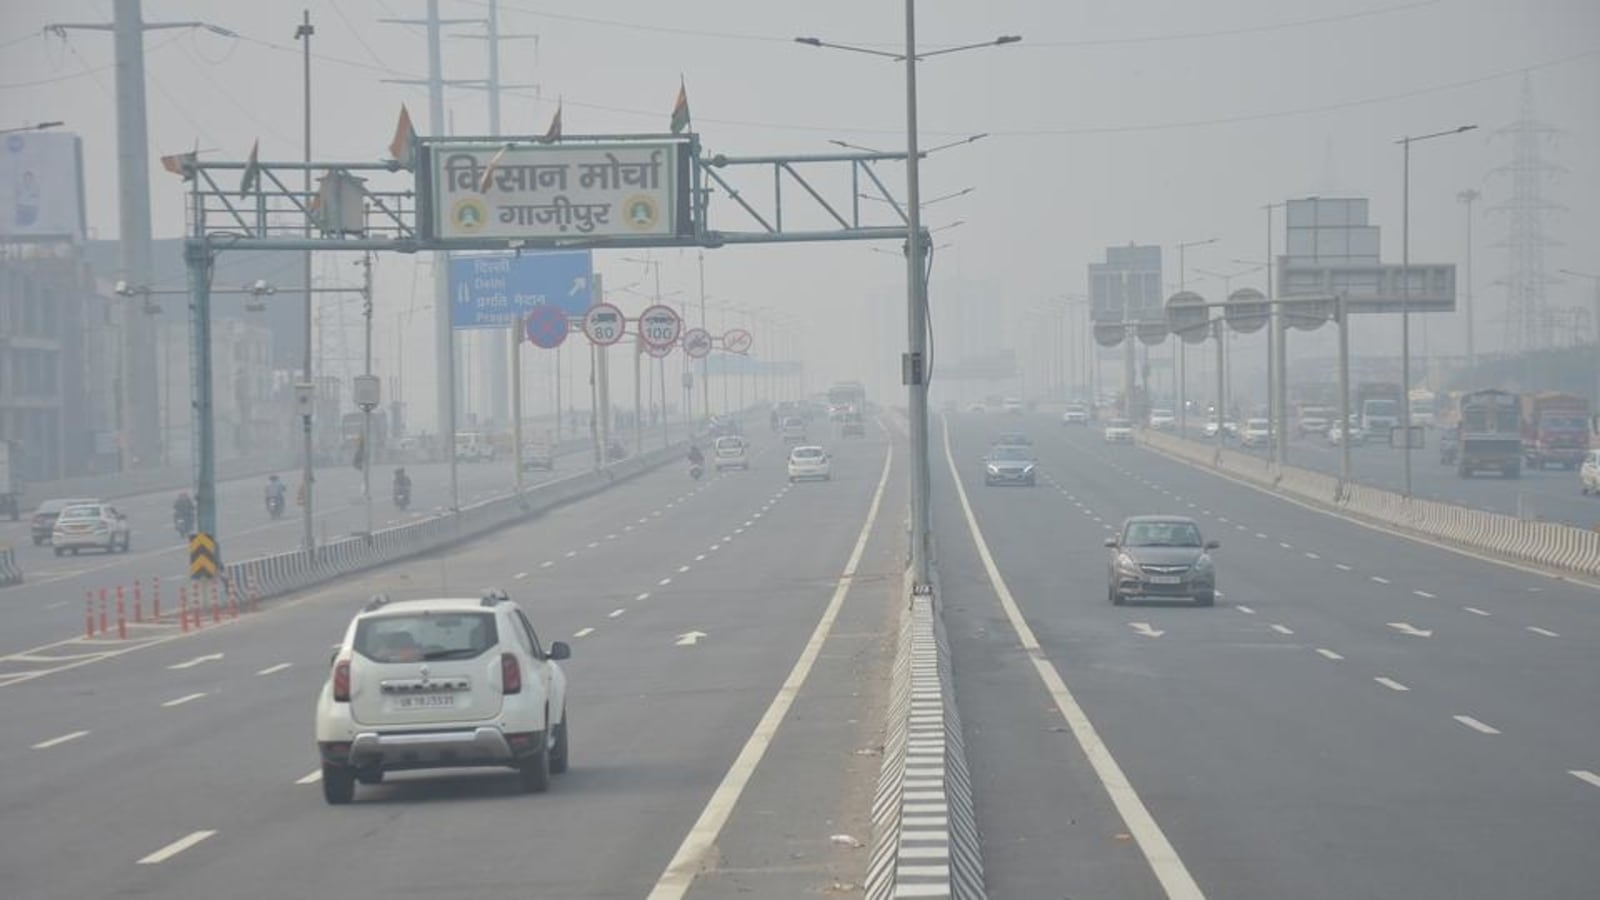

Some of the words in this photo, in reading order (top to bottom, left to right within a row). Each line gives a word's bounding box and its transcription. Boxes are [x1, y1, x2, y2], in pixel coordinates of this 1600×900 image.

[443, 153, 571, 193] किसान
[576, 150, 664, 191] मोर्चा
[496, 195, 613, 233] गाज़ीपुर
[594, 326, 614, 340] 80
[646, 327, 673, 340] 100
